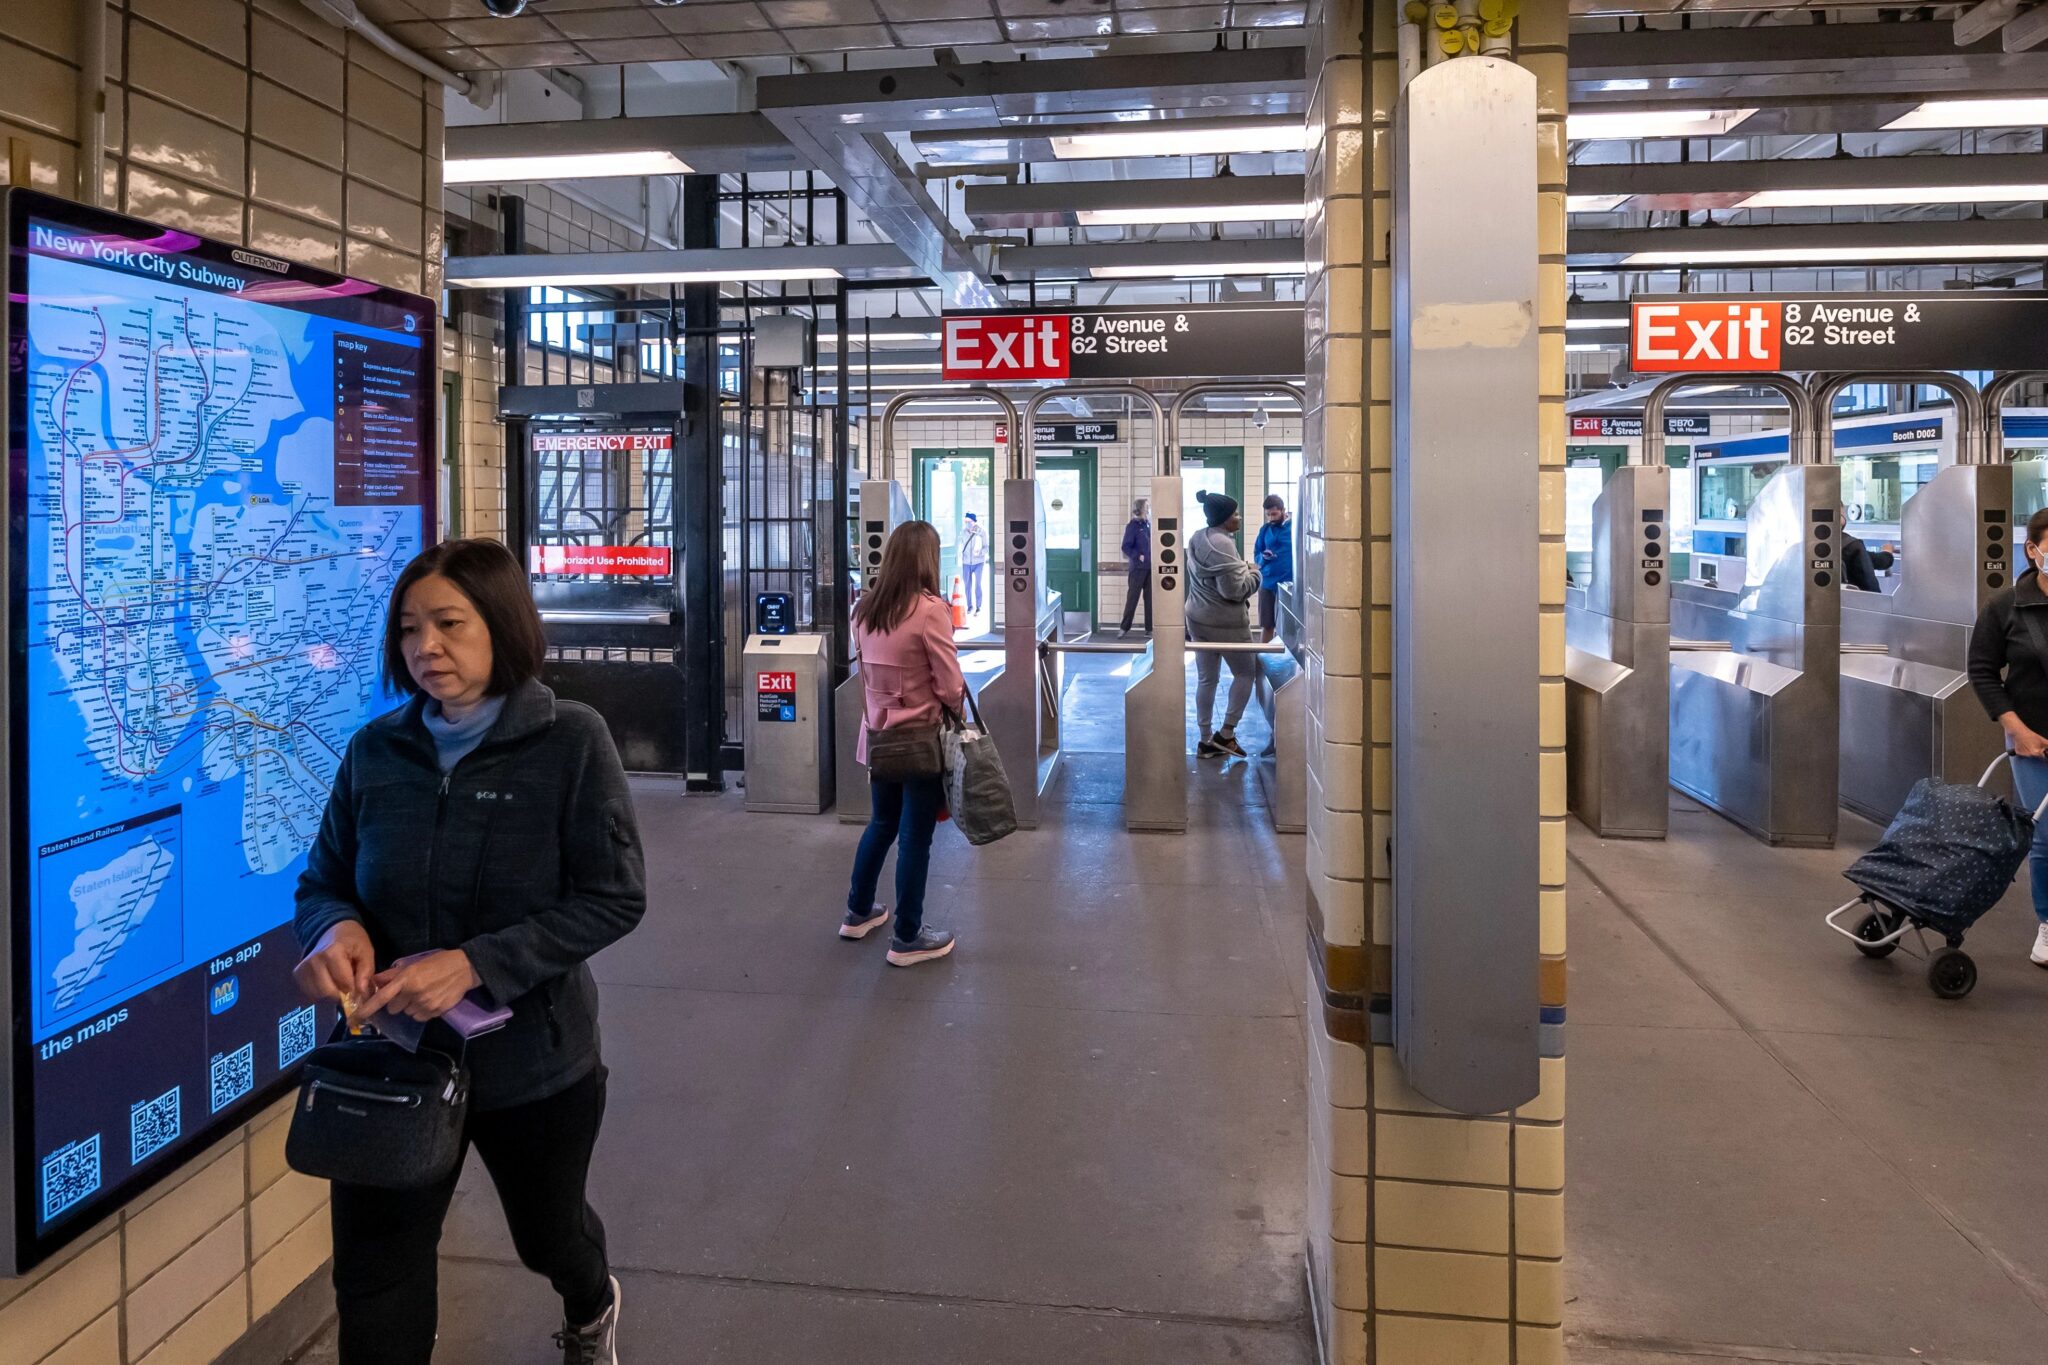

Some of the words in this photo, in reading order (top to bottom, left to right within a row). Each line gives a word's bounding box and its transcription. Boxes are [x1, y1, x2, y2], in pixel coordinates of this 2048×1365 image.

[36, 226, 85, 255] New
[89, 238, 135, 267] York
[138, 252, 176, 279] City
[179, 261, 245, 293] Subway
[1785, 304, 1801, 323] 8
[1810, 304, 1894, 323] Avenue
[1903, 303, 1921, 322] &
[1071, 317, 1086, 334] 8
[1094, 316, 1166, 334] Avenue
[1174, 314, 1189, 332] &
[1636, 305, 1769, 360] Exit
[1784, 326, 1815, 346] 62
[1823, 324, 1896, 345] Street
[238, 342, 253, 353] The
[255, 345, 278, 357] Bronx
[338, 340, 355, 350] map
[355, 342, 368, 353] key
[946, 318, 1060, 370] Exit
[1071, 336, 1097, 354] 62
[1105, 335, 1168, 354] Street
[1085, 425, 1101, 433] B70
[1573, 419, 1599, 430] Exit
[1676, 419, 1694, 427] B70
[1601, 427, 1613, 435] 62
[1616, 427, 1643, 435] Street
[1892, 431, 1915, 441] Booth
[1916, 429, 1936, 439] D002
[536, 436, 627, 450] EMERGENCY
[633, 436, 667, 449] EXIT
[95, 525, 151, 535] Manhattan
[596, 556, 615, 565] Use
[616, 556, 664, 566] Prohibited
[1645, 560, 1659, 568] Exit
[1814, 560, 1830, 568] Exit
[1986, 562, 2003, 570] Exit
[759, 674, 792, 690] Exit
[40, 842, 70, 856] Staten
[70, 833, 95, 847] Island
[95, 823, 125, 838] Railway
[73, 878, 111, 897] Staten
[112, 864, 144, 880] Island
[210, 954, 233, 976] the
[235, 942, 262, 963] app
[214, 979, 234, 998] MY
[214, 991, 234, 1008] mta
[40, 1035, 74, 1061] the
[77, 1006, 129, 1044] maps
[211, 1052, 223, 1064] iOS
[131, 1099, 146, 1112] bus
[42, 1140, 77, 1164] subway
